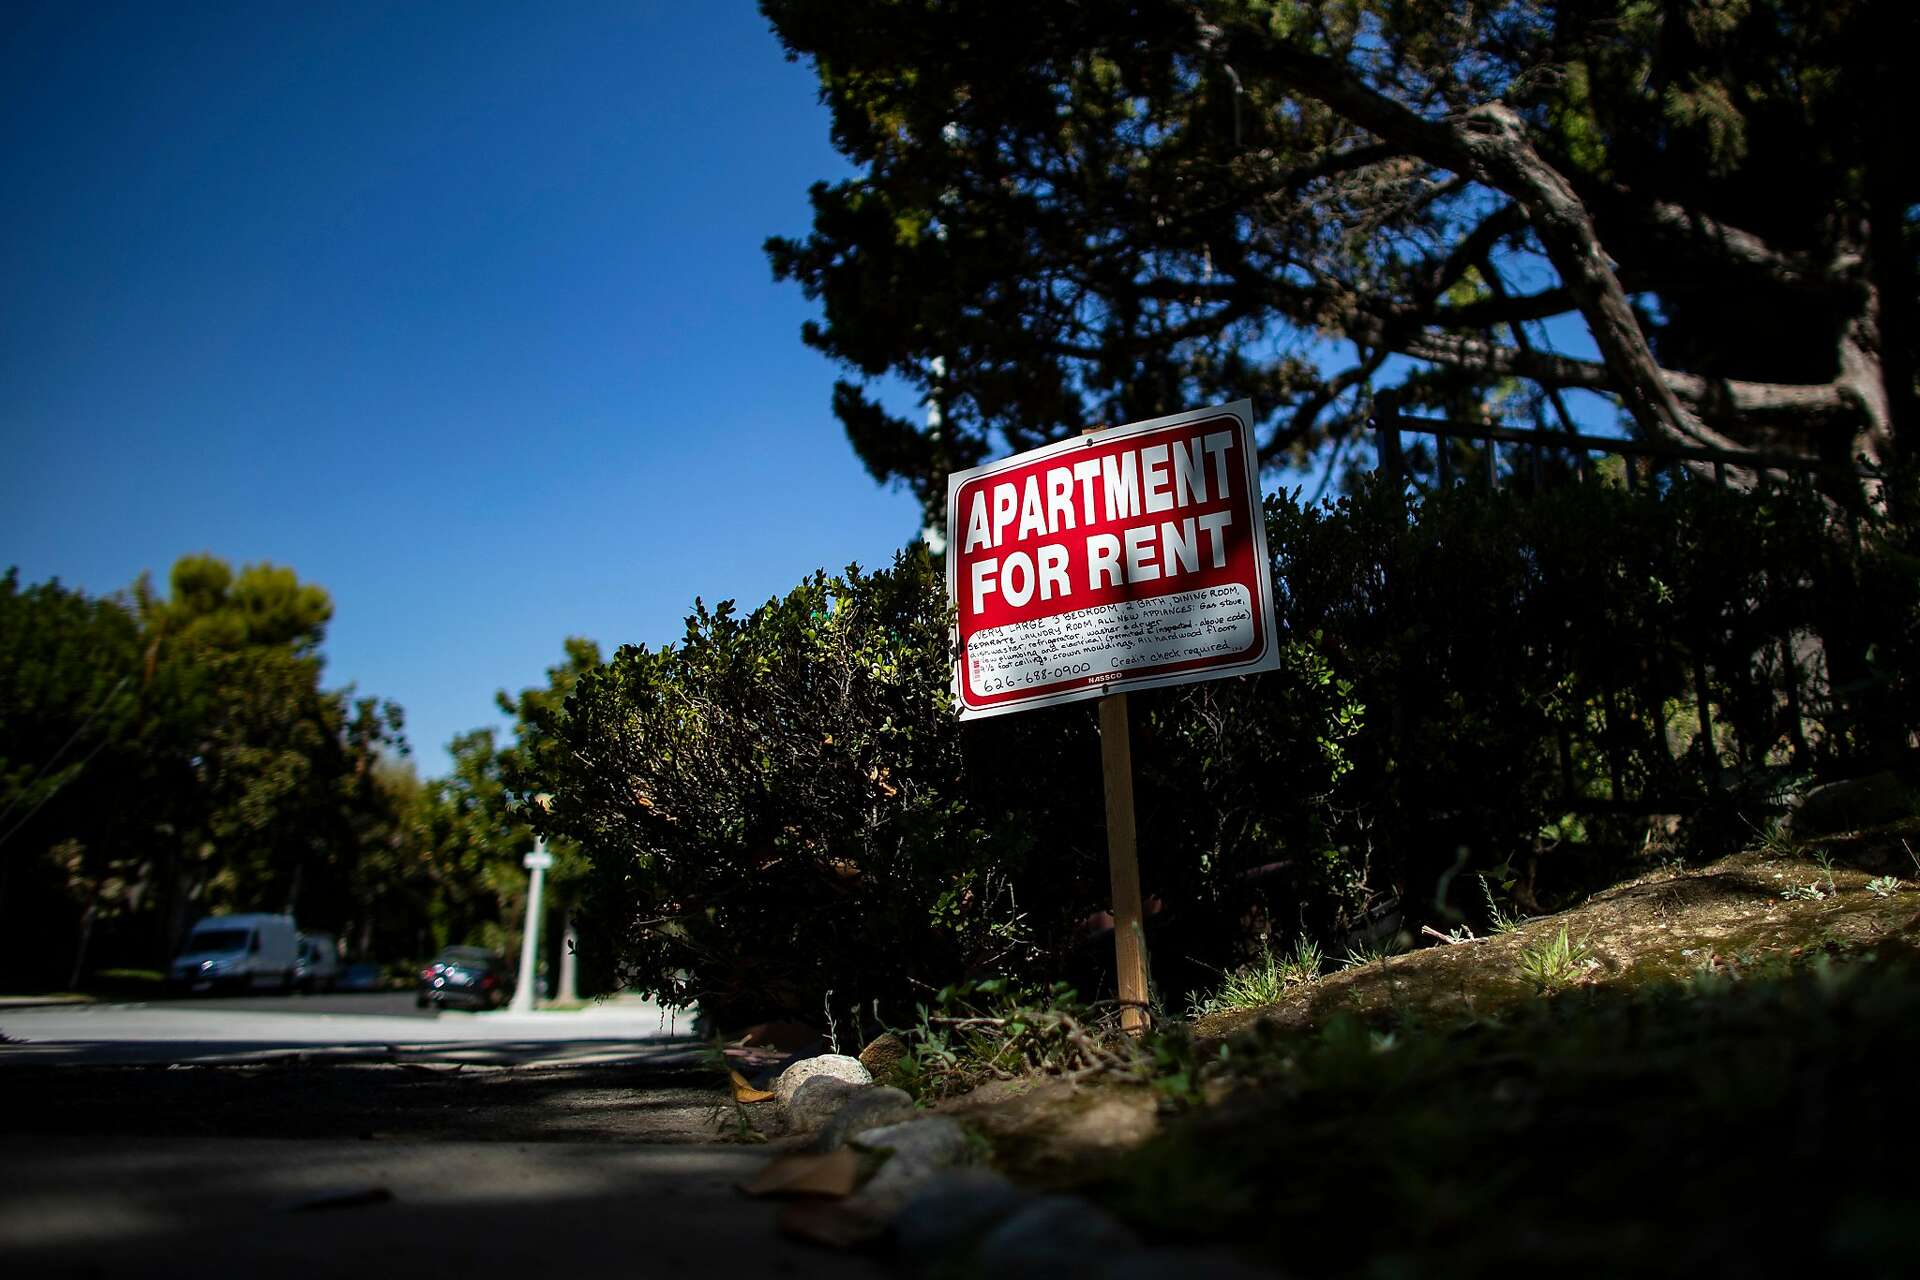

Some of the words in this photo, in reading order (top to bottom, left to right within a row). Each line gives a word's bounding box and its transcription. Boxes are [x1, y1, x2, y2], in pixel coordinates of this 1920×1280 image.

[964, 430, 1233, 554] APARTMENT
[971, 543, 1072, 615] FOR
[1086, 511, 1232, 591] RENT
[968, 637, 1016, 651] SEPARATE
[1020, 627, 1062, 641] LAUNDRY
[1066, 620, 1097, 631] ROOM,
[1098, 617, 1115, 625] ALL
[1117, 613, 1139, 622] NEW
[1200, 602, 1217, 610] Gas
[1220, 598, 1245, 608] stove,
[976, 628, 1003, 640] VERY
[1009, 618, 1045, 633] LARGE
[1126, 602, 1133, 611] 2
[1172, 592, 1207, 604] DINING
[1209, 586, 1240, 598] ROOM,
[999, 649, 1040, 663] plumbing
[1061, 635, 1101, 649] electrical
[1200, 617, 1224, 626] above
[1227, 609, 1251, 621] code)
[1086, 625, 1120, 637] washer
[1131, 620, 1162, 631] dryer
[984, 662, 1091, 692] 626-688-0900
[1111, 654, 1146, 668] Credit
[1151, 649, 1181, 662] check
[998, 661, 1013, 670] foot
[1053, 649, 1081, 660] crown
[1138, 635, 1153, 644] All
[1154, 628, 1203, 641] hardwood
[1206, 624, 1237, 635] floors
[1088, 672, 1123, 684] NASSCO
